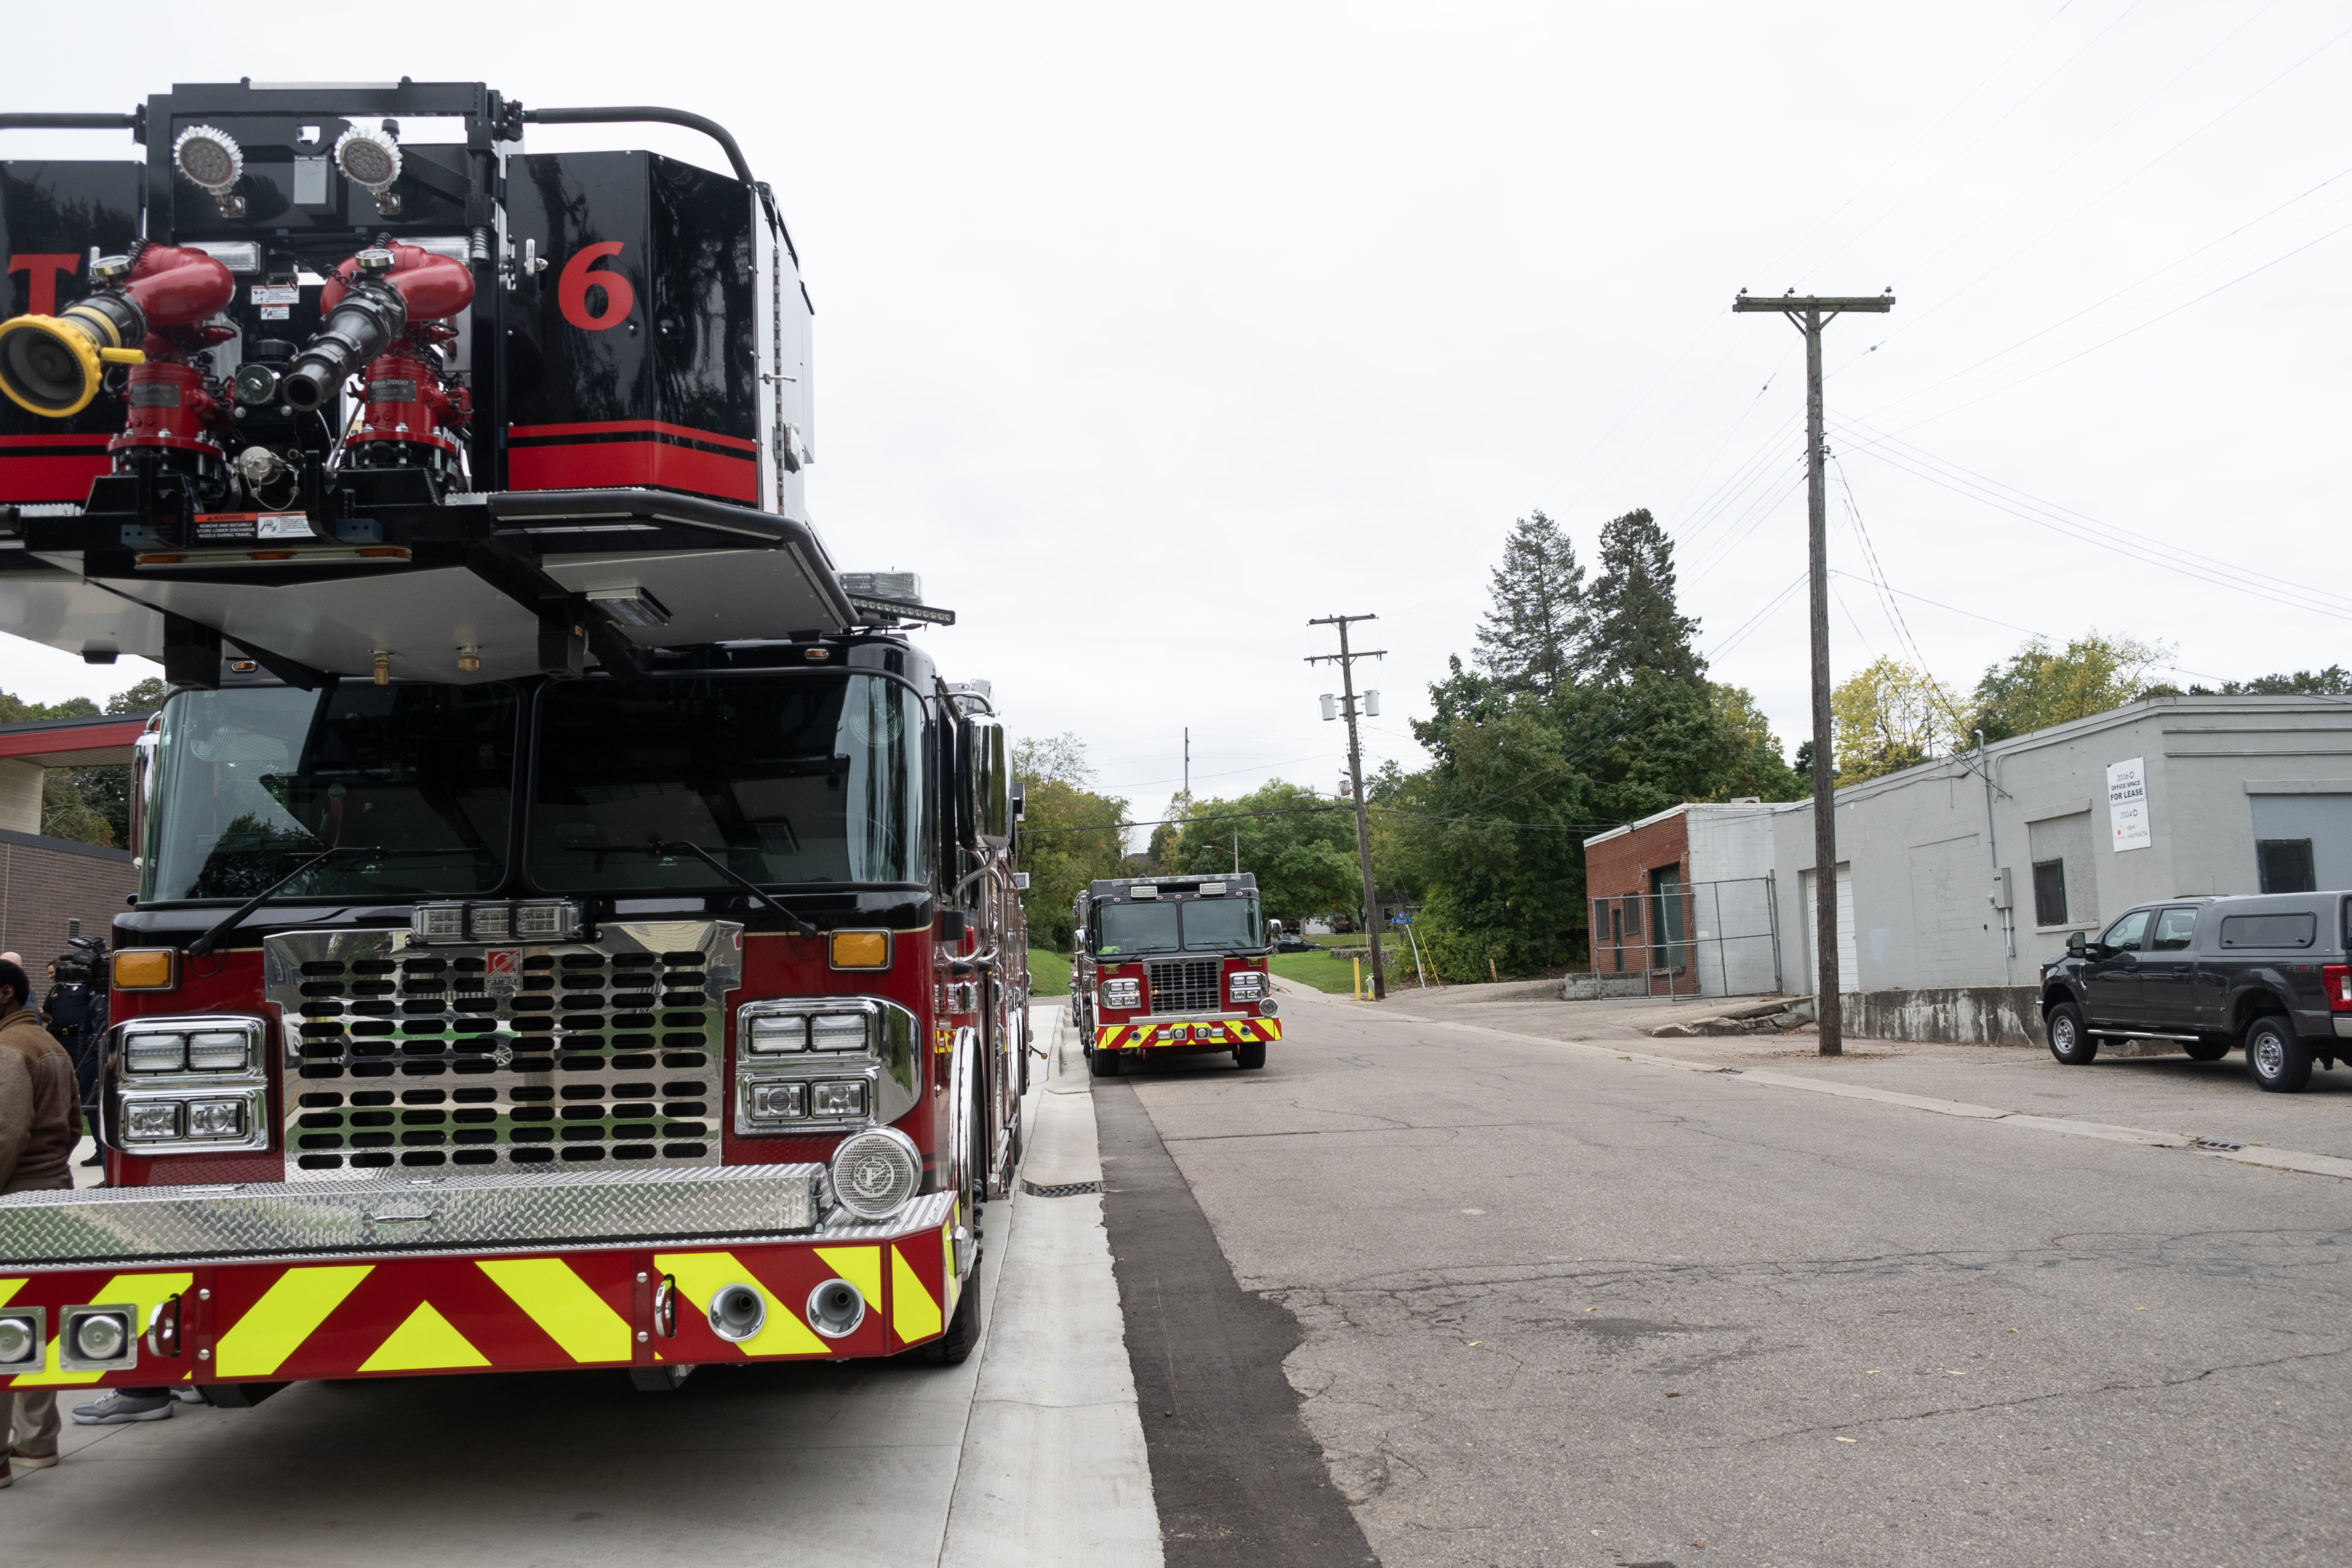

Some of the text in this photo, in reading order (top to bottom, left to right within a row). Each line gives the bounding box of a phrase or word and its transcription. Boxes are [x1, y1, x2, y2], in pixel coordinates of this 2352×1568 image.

[7, 253, 81, 318] T
[558, 241, 634, 330] 6
[2110, 788, 2143, 801] FOR LEASE
